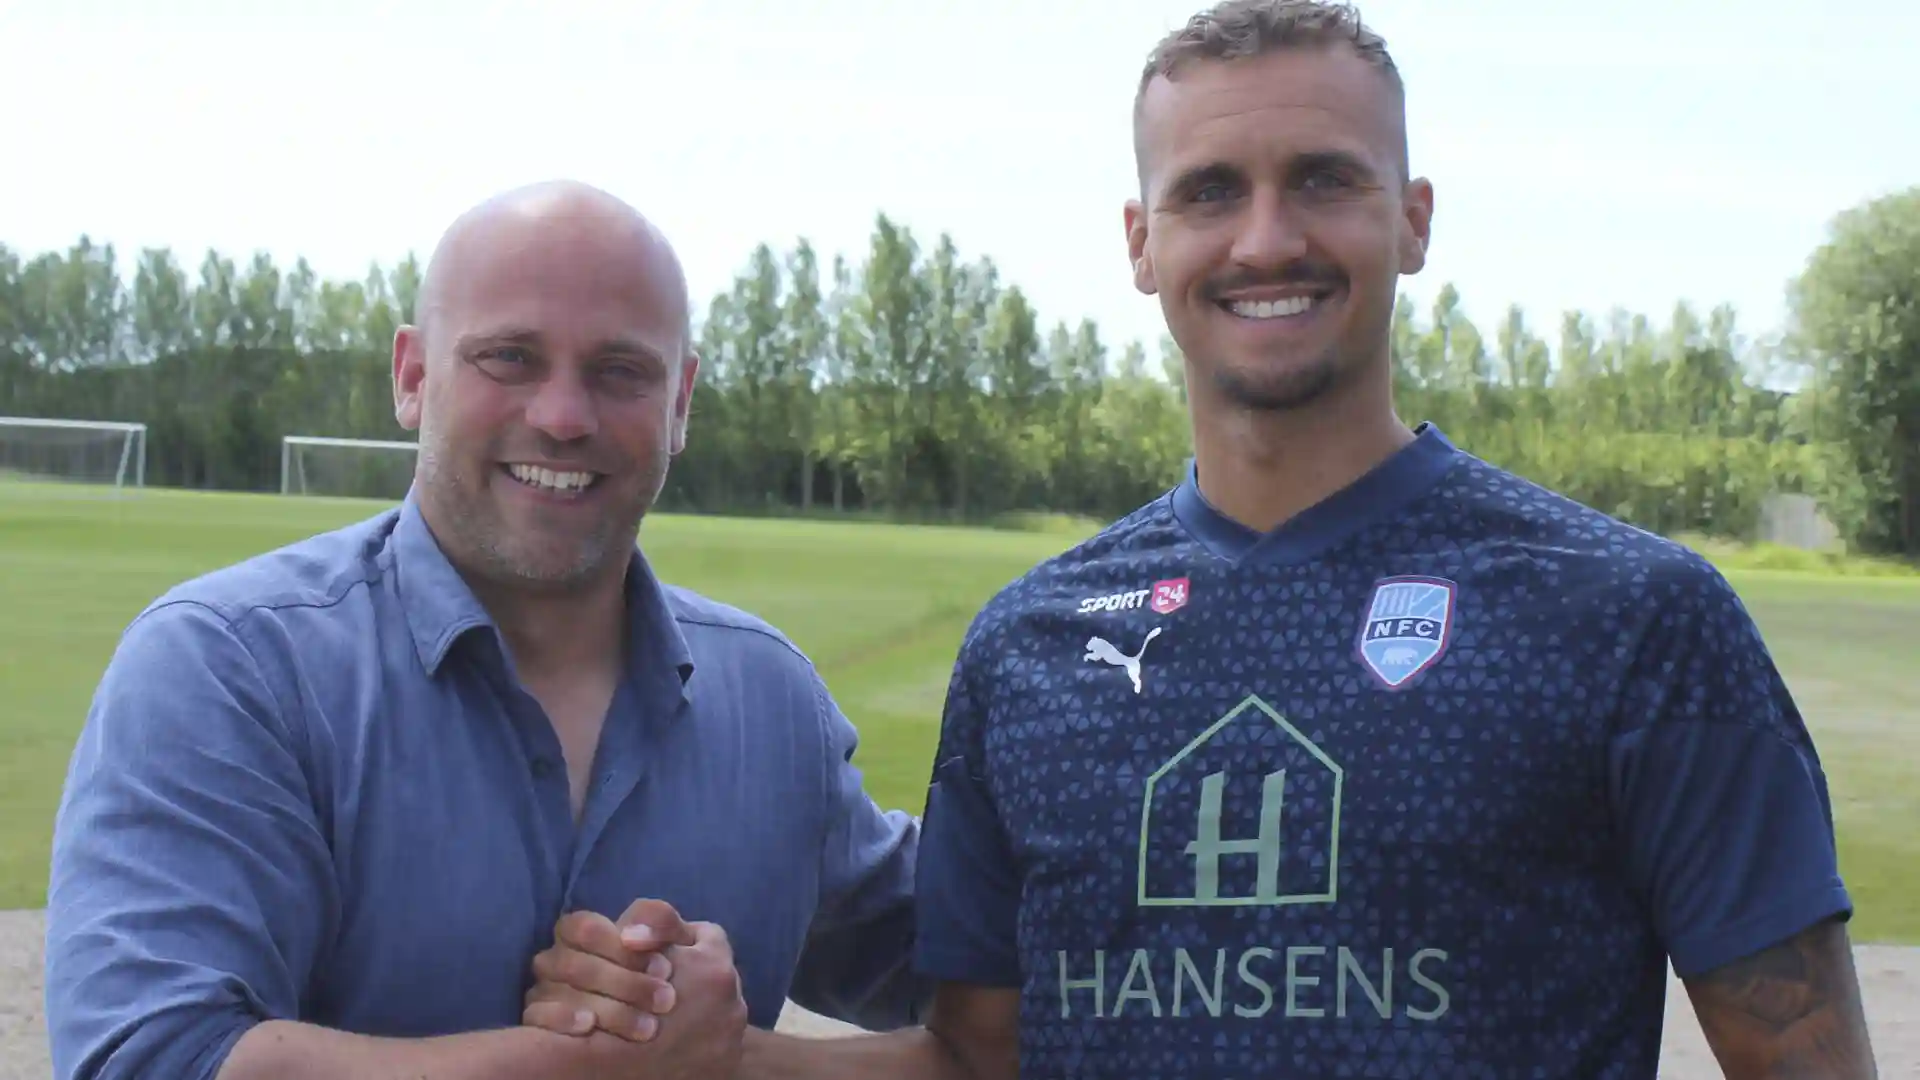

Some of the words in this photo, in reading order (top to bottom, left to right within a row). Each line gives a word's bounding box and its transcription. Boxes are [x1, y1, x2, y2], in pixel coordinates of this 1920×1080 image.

[1076, 589, 1150, 613] SPORT
[1155, 583, 1185, 606] 24
[1374, 620, 1434, 637] NFC
[1184, 768, 1286, 902] H
[1057, 945, 1450, 1021] HANSENS
